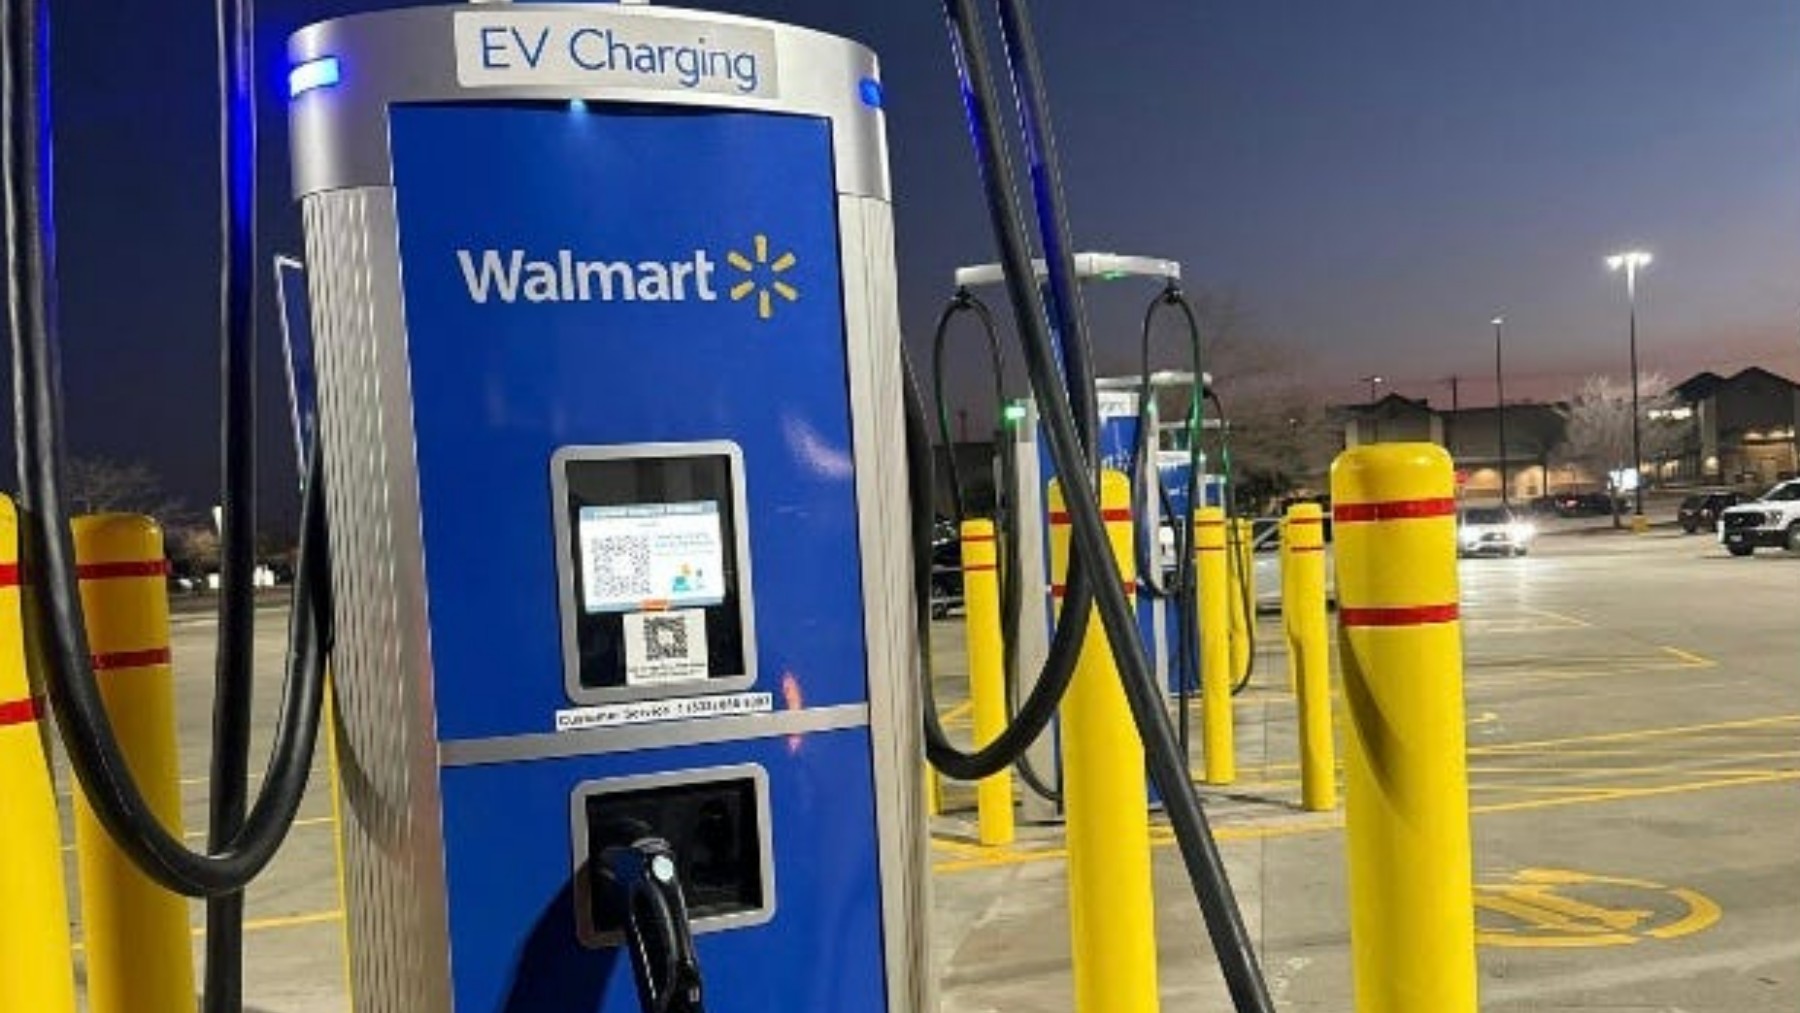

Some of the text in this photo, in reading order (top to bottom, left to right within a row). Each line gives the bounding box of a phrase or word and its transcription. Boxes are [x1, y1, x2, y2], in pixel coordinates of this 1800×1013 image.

[480, 27, 758, 92] EV Charging
[456, 249, 718, 303] Walmart
